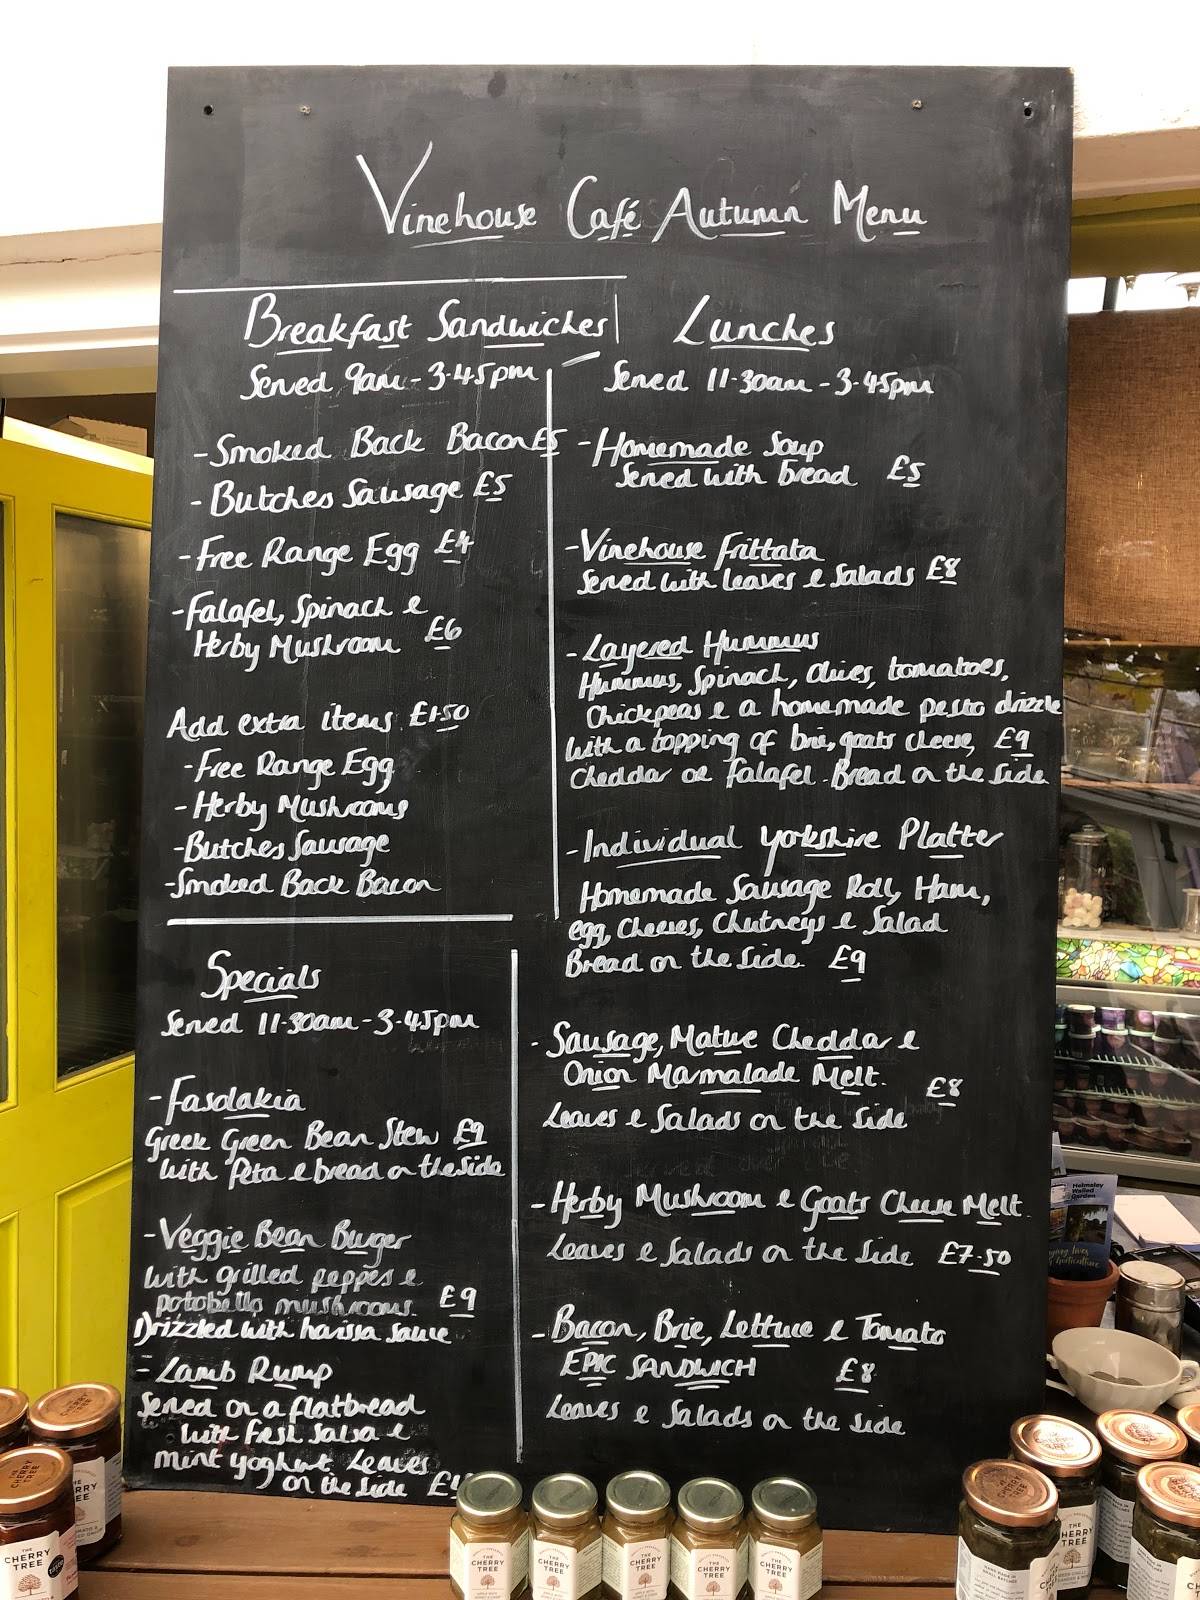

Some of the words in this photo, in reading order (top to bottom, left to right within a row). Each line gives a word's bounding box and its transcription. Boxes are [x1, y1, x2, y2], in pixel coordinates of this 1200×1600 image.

[356, 142, 537, 235] Vinehouse
[567, 176, 641, 240] Café
[652, 186, 808, 242] Autumn
[834, 180, 927, 242] Menu
[244, 293, 413, 349] Breakfast
[427, 299, 609, 341] Sandwiches
[673, 295, 835, 346] Lunches
[350, 425, 425, 458] Back
[446, 421, 531, 454] Bacon
[762, 431, 823, 462] Soup
[777, 459, 858, 486] bread
[886, 454, 926, 482] £5
[341, 478, 463, 513] Sausage
[472, 471, 513, 497] £5
[261, 537, 353, 576] Range
[363, 532, 420, 575] Egg
[433, 529, 474, 555] £4
[925, 555, 961, 580] £8
[291, 594, 393, 628] Spinach
[193, 630, 260, 672] Herby
[269, 631, 401, 664] Mushroom
[424, 616, 462, 642] £6
[704, 629, 820, 666] Hummus
[687, 663, 797, 697] Spinach,
[888, 656, 1009, 684] tomatoes,
[739, 699, 761, 716] a
[773, 688, 910, 718] homemade
[919, 697, 985, 722] pesto
[995, 690, 1062, 715] drizzle
[166, 707, 229, 742] Add
[238, 710, 305, 734] extra
[321, 703, 393, 733] items
[619, 736, 646, 754] a
[652, 730, 740, 761] topping
[750, 730, 775, 756] of
[839, 729, 895, 762] goats
[993, 728, 1031, 751] £9
[257, 750, 336, 790] Range
[341, 748, 395, 794] Egg
[945, 758, 985, 783] the
[277, 795, 409, 823] Mushrooms
[288, 830, 391, 867] Sausage
[898, 817, 1004, 850] Platter
[281, 868, 349, 898] Back
[356, 869, 442, 898] Bacon
[579, 880, 717, 913] Homemade
[725, 873, 832, 914] Sausage
[915, 873, 991, 906] Ham,
[201, 950, 321, 1000] Specials
[565, 947, 644, 977] Bread
[649, 952, 682, 971] on
[691, 944, 732, 969] the
[828, 944, 866, 973] £9
[772, 1023, 893, 1052] Cheddar
[563, 1059, 635, 1087] Onion
[647, 1061, 800, 1093] Marmalade
[926, 1077, 963, 1098] £8
[542, 1101, 619, 1128] Leaves
[794, 1106, 842, 1130] the
[145, 1126, 211, 1162] Greek
[221, 1129, 292, 1165] Green
[304, 1120, 374, 1151] Bean
[378, 1117, 439, 1149] Stew
[453, 1118, 487, 1143] £9
[314, 1158, 383, 1184] bread
[635, 1183, 767, 1211] Mushroom
[800, 1185, 871, 1233] Goats
[254, 1218, 326, 1249] Bean
[546, 1234, 625, 1261] Leaves
[802, 1236, 848, 1262] the
[216, 1266, 304, 1296] grilled
[440, 1285, 477, 1311] £9
[653, 1307, 712, 1346] Brie,
[719, 1309, 815, 1342] Lettuce
[855, 1312, 946, 1345] Tomato
[247, 1356, 333, 1390] Rump
[560, 1346, 617, 1377] EPIC
[626, 1355, 757, 1380] SANDWICH
[836, 1357, 877, 1383] £8
[225, 1400, 260, 1416] on
[263, 1401, 283, 1417] a
[288, 1394, 425, 1424] flatbread
[545, 1393, 620, 1420] Leaves
[802, 1407, 840, 1431] the
[76, 1483, 97, 1493] RRY
[76, 1493, 90, 1502] EE
[282, 1477, 314, 1494] on
[321, 1474, 351, 1496] the
[425, 1471, 472, 1496] £1
[1061, 1527, 1093, 1538] HERRY
[1061, 1538, 1087, 1546] TREE
[5, 1548, 50, 1563] CHERRY
[13, 1560, 43, 1571] TREE
[538, 1559, 570, 1568] CHERRY
[544, 1566, 564, 1574] TREE
[629, 1557, 661, 1567] CHERRY
[635, 1563, 656, 1571] TREE
[759, 1561, 792, 1571] CHERRY
[766, 1568, 787, 1577] TREE
